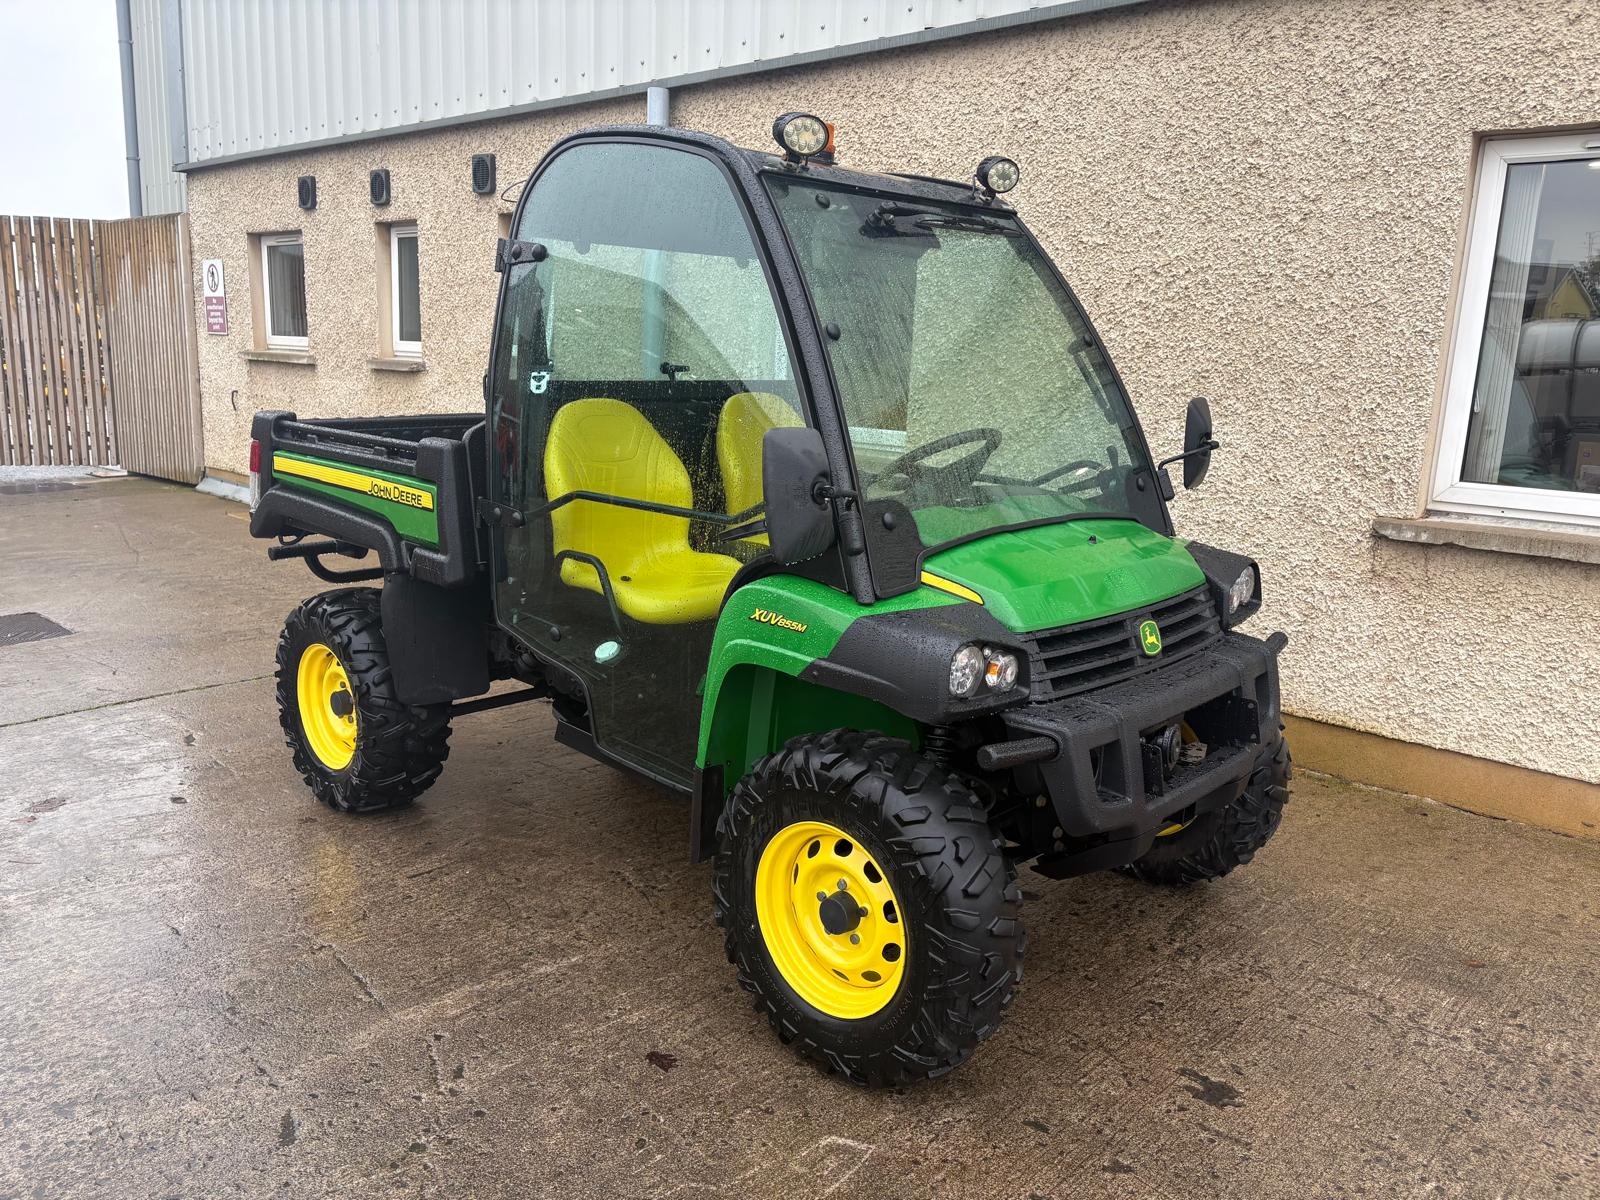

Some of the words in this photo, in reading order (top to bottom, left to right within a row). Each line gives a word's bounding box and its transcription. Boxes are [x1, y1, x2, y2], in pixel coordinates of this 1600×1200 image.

[368, 480, 392, 498] JOHN
[393, 486, 423, 506] DEERE
[750, 607, 808, 633] XUV855M
